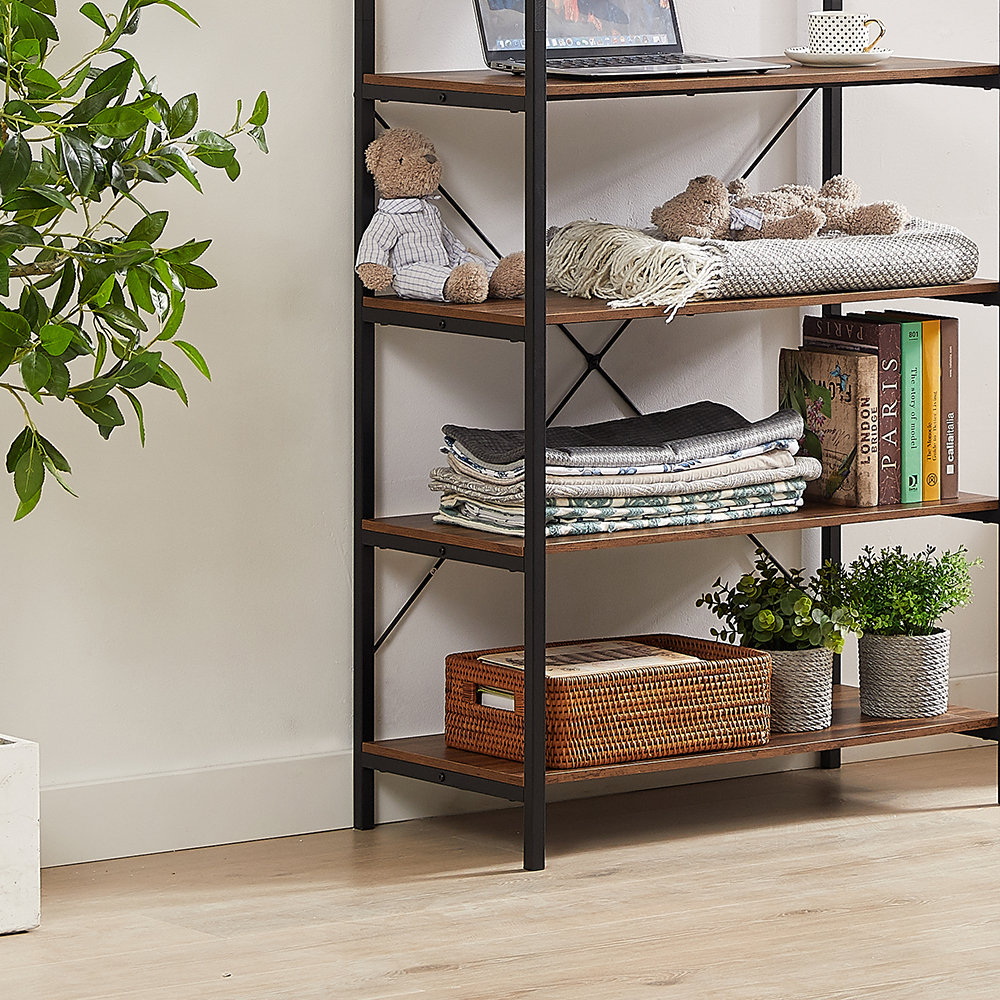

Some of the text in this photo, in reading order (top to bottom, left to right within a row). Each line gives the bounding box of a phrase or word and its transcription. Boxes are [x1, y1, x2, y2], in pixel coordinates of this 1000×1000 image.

[816, 320, 864, 341] PARIS
[860, 397, 871, 465] LONDON
[881, 358, 898, 471] PARIS
[911, 411, 918, 420] of
[946, 412, 954, 462] caliaitalia
